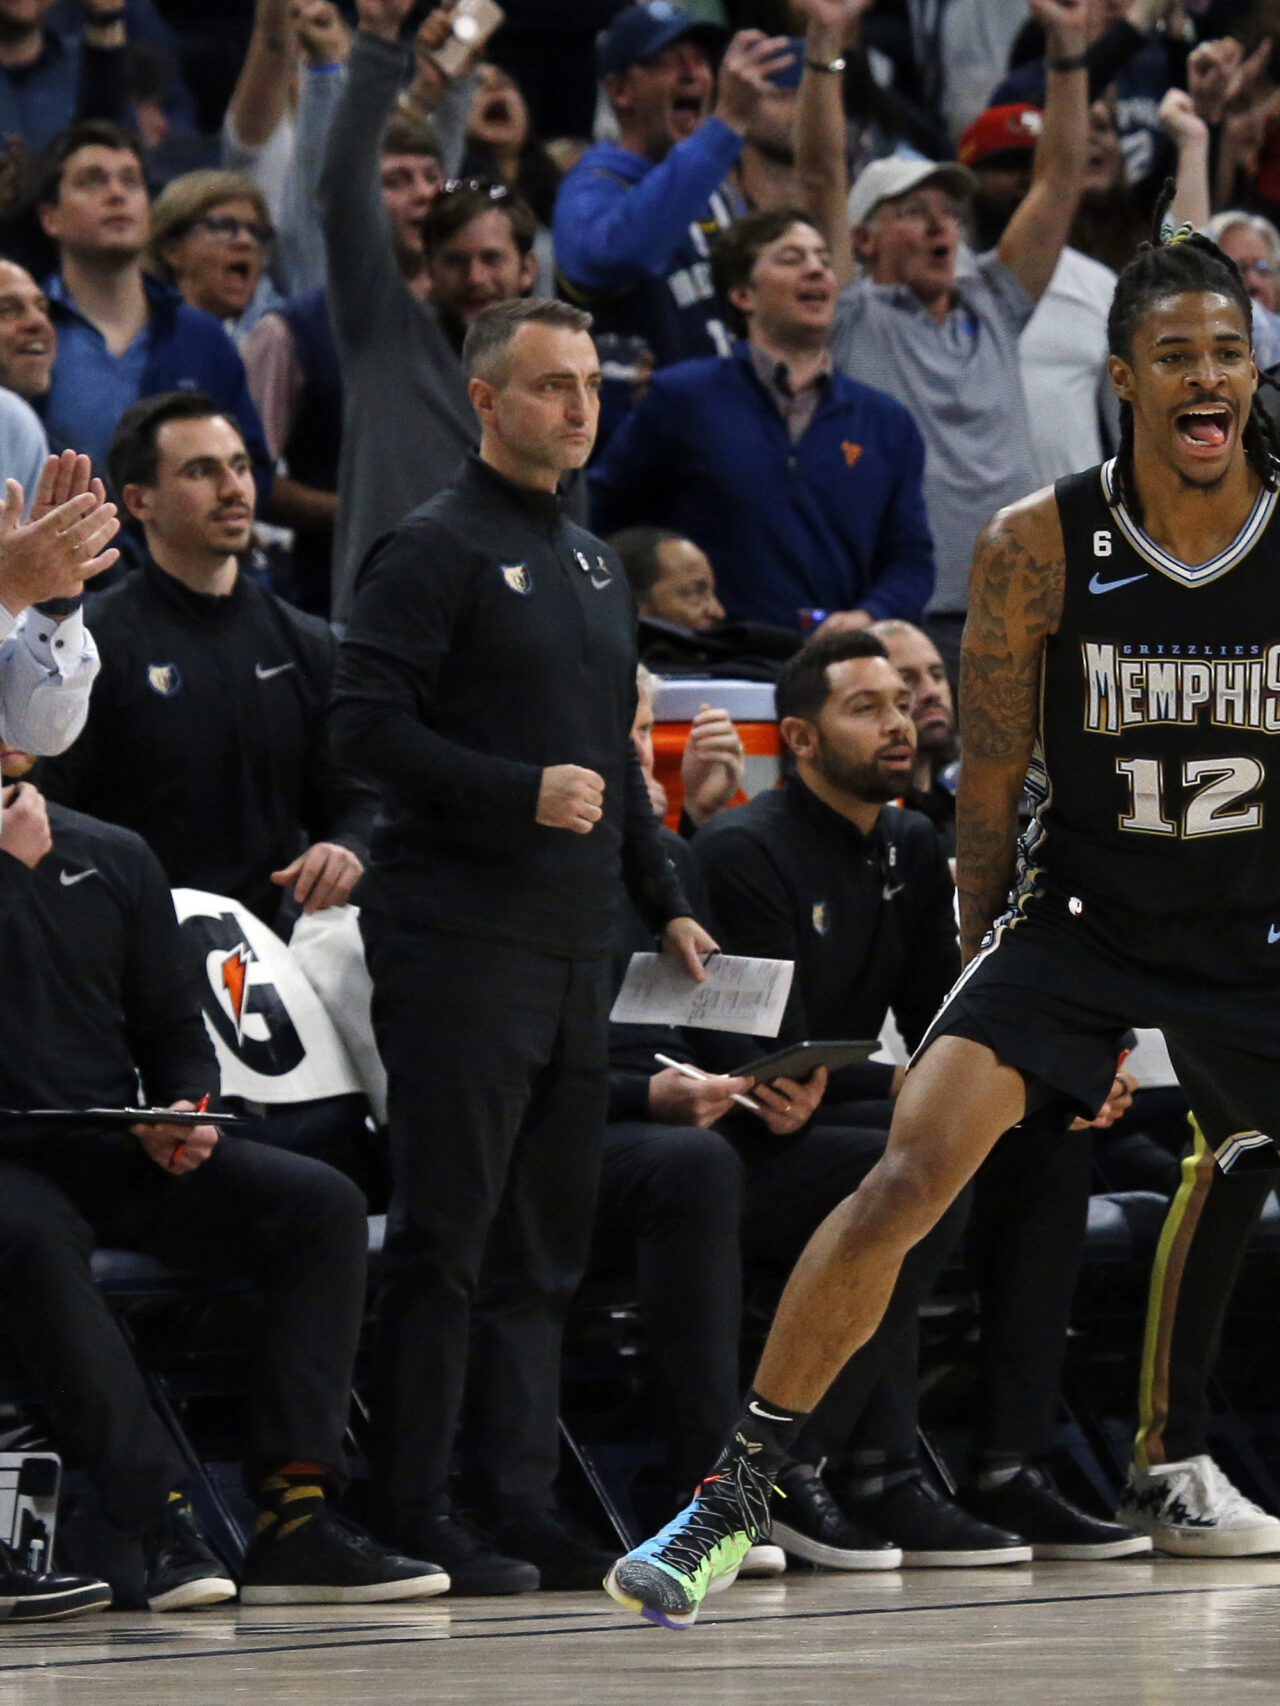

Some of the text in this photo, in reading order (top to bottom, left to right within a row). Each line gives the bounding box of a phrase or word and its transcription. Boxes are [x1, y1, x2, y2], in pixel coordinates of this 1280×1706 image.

[1093, 530, 1112, 557] 6
[1123, 645, 1260, 654] GRIZZLIES
[1116, 756, 1265, 840] 12
